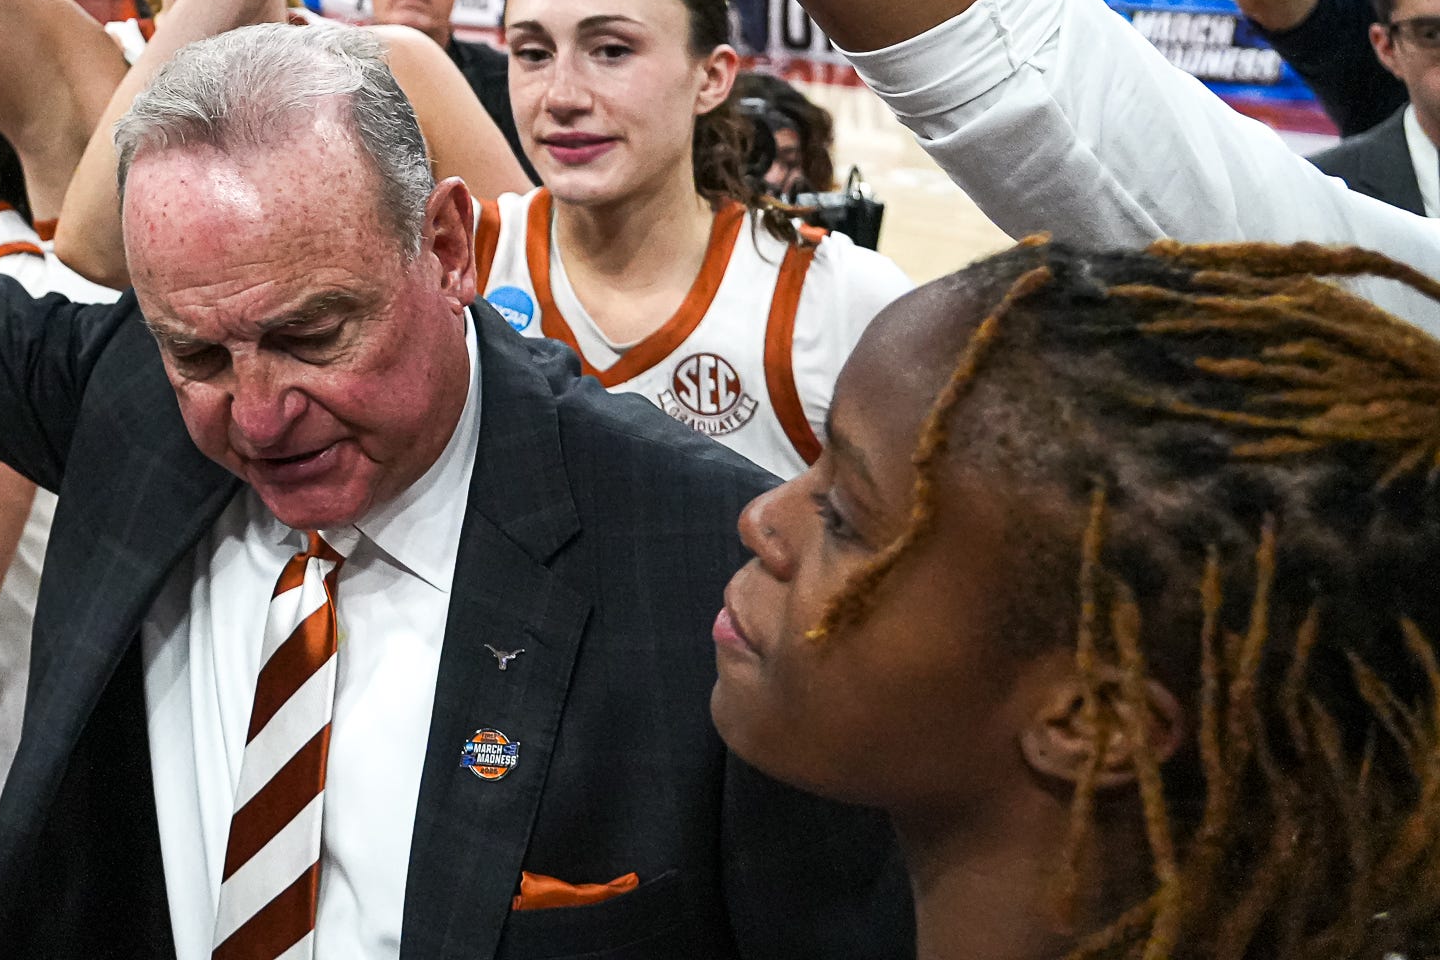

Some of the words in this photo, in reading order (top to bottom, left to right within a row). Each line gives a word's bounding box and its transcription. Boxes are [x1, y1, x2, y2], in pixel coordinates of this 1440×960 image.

[1133, 10, 1236, 45] MARCH
[676, 354, 736, 414] SEC
[474, 744, 503, 754] MARCH
[477, 753, 517, 765] MADNESS
